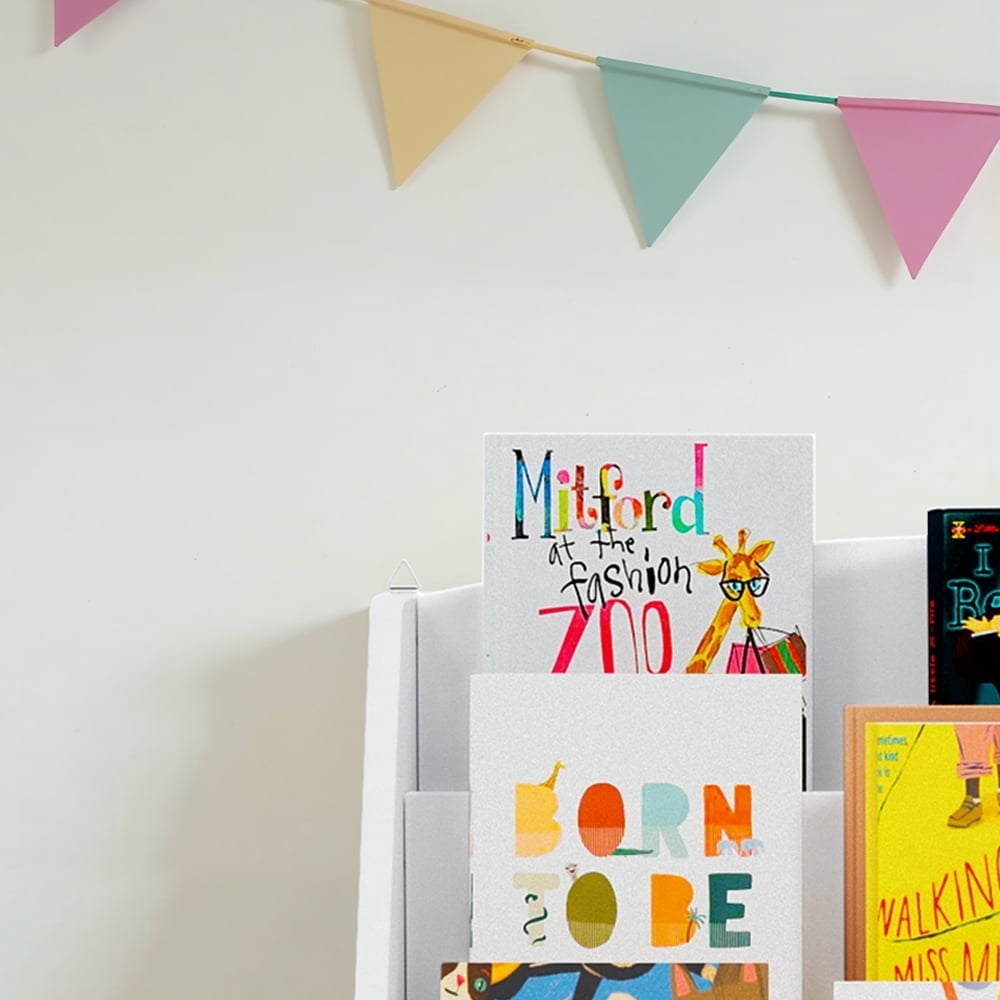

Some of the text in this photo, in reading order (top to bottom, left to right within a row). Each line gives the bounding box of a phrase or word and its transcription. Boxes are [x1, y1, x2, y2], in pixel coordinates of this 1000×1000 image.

[511, 443, 710, 540] Mitford
[549, 529, 635, 566] at the
[560, 547, 693, 620] fashion
[974, 543, 993, 576] I
[514, 782, 753, 858] BORN
[512, 871, 753, 949] TO BE
